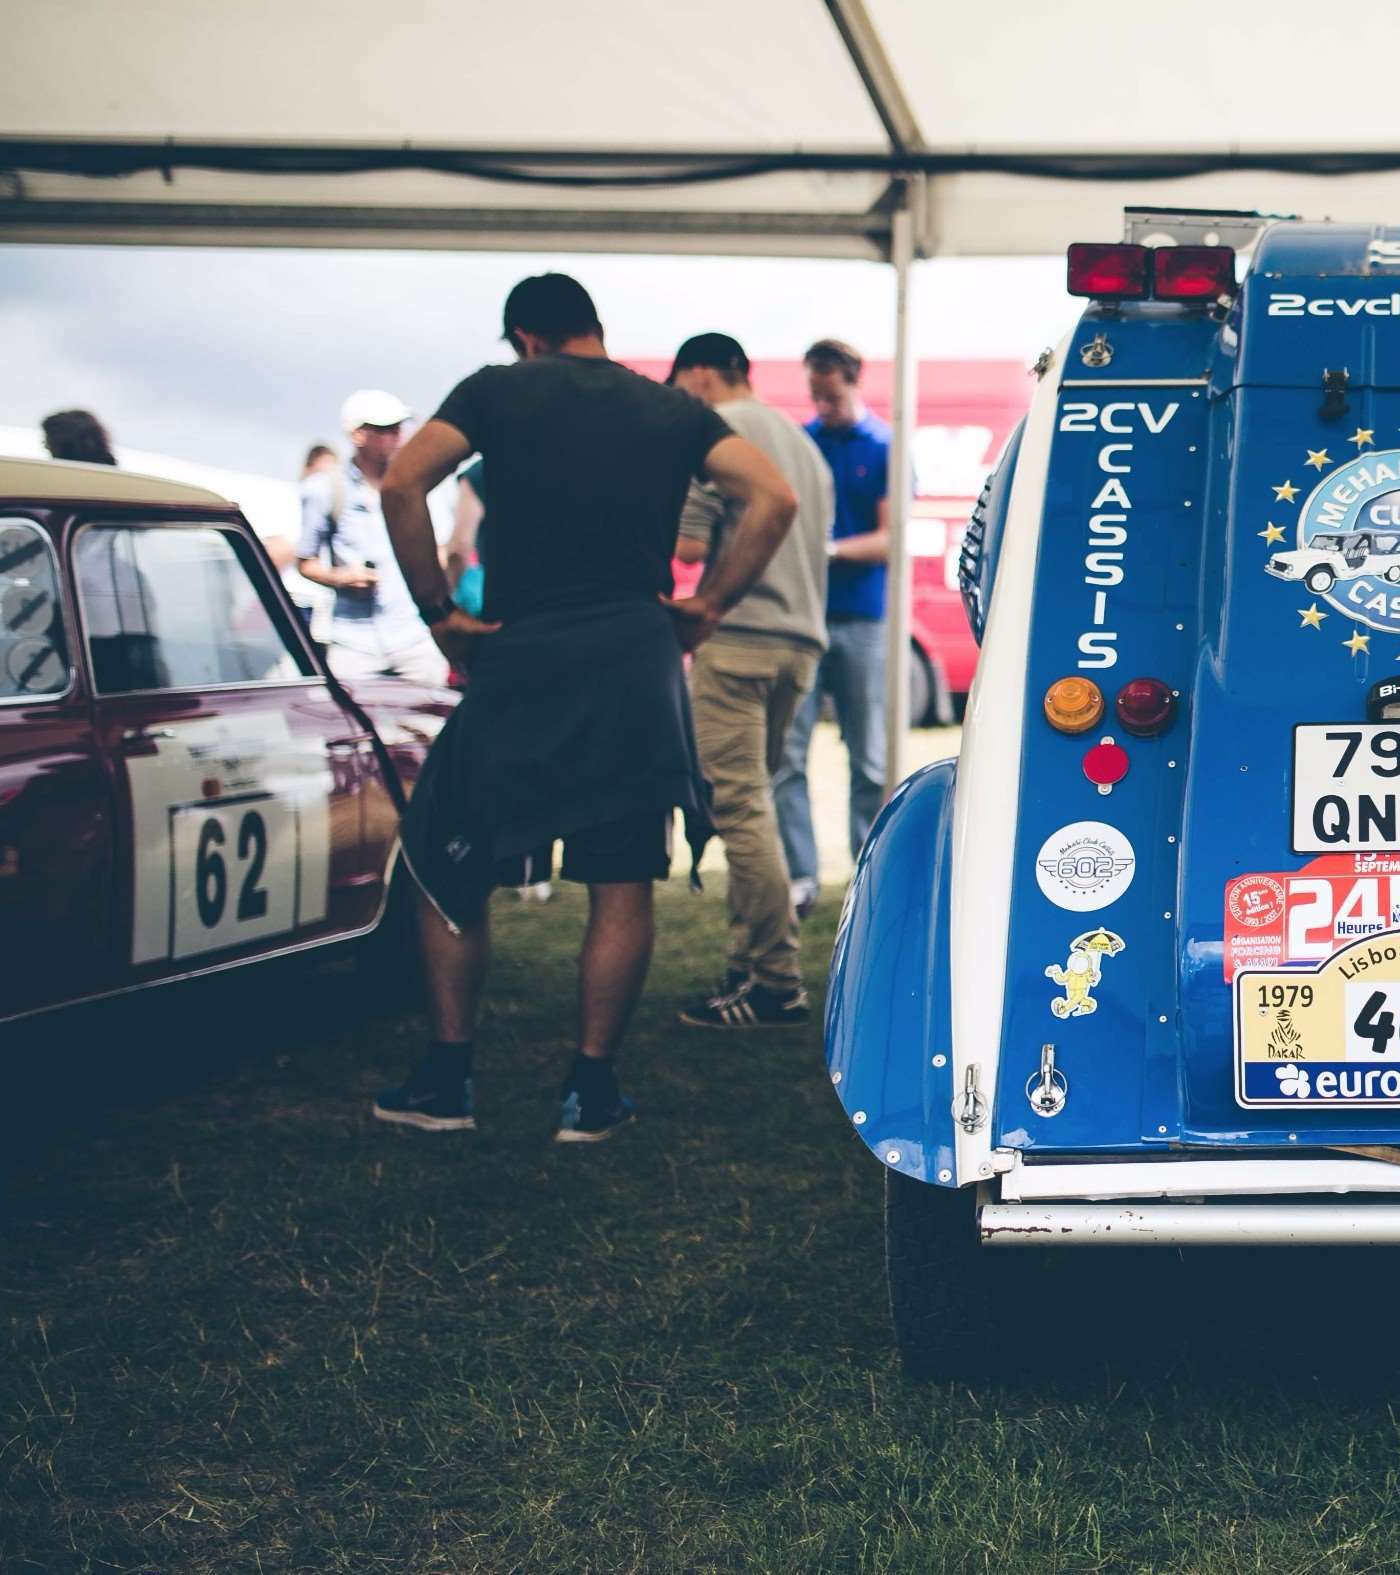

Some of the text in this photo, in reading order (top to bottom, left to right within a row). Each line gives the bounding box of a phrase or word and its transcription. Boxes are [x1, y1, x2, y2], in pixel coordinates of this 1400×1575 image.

[1059, 402, 1180, 435] 2CV
[1077, 443, 1133, 669] CASSIS
[1312, 795, 1398, 844] QN
[196, 808, 268, 929] 62
[1058, 857, 1113, 878] 602
[1289, 877, 1386, 958] 24
[1337, 921, 1384, 935] Heures
[1258, 985, 1313, 1008] 1979
